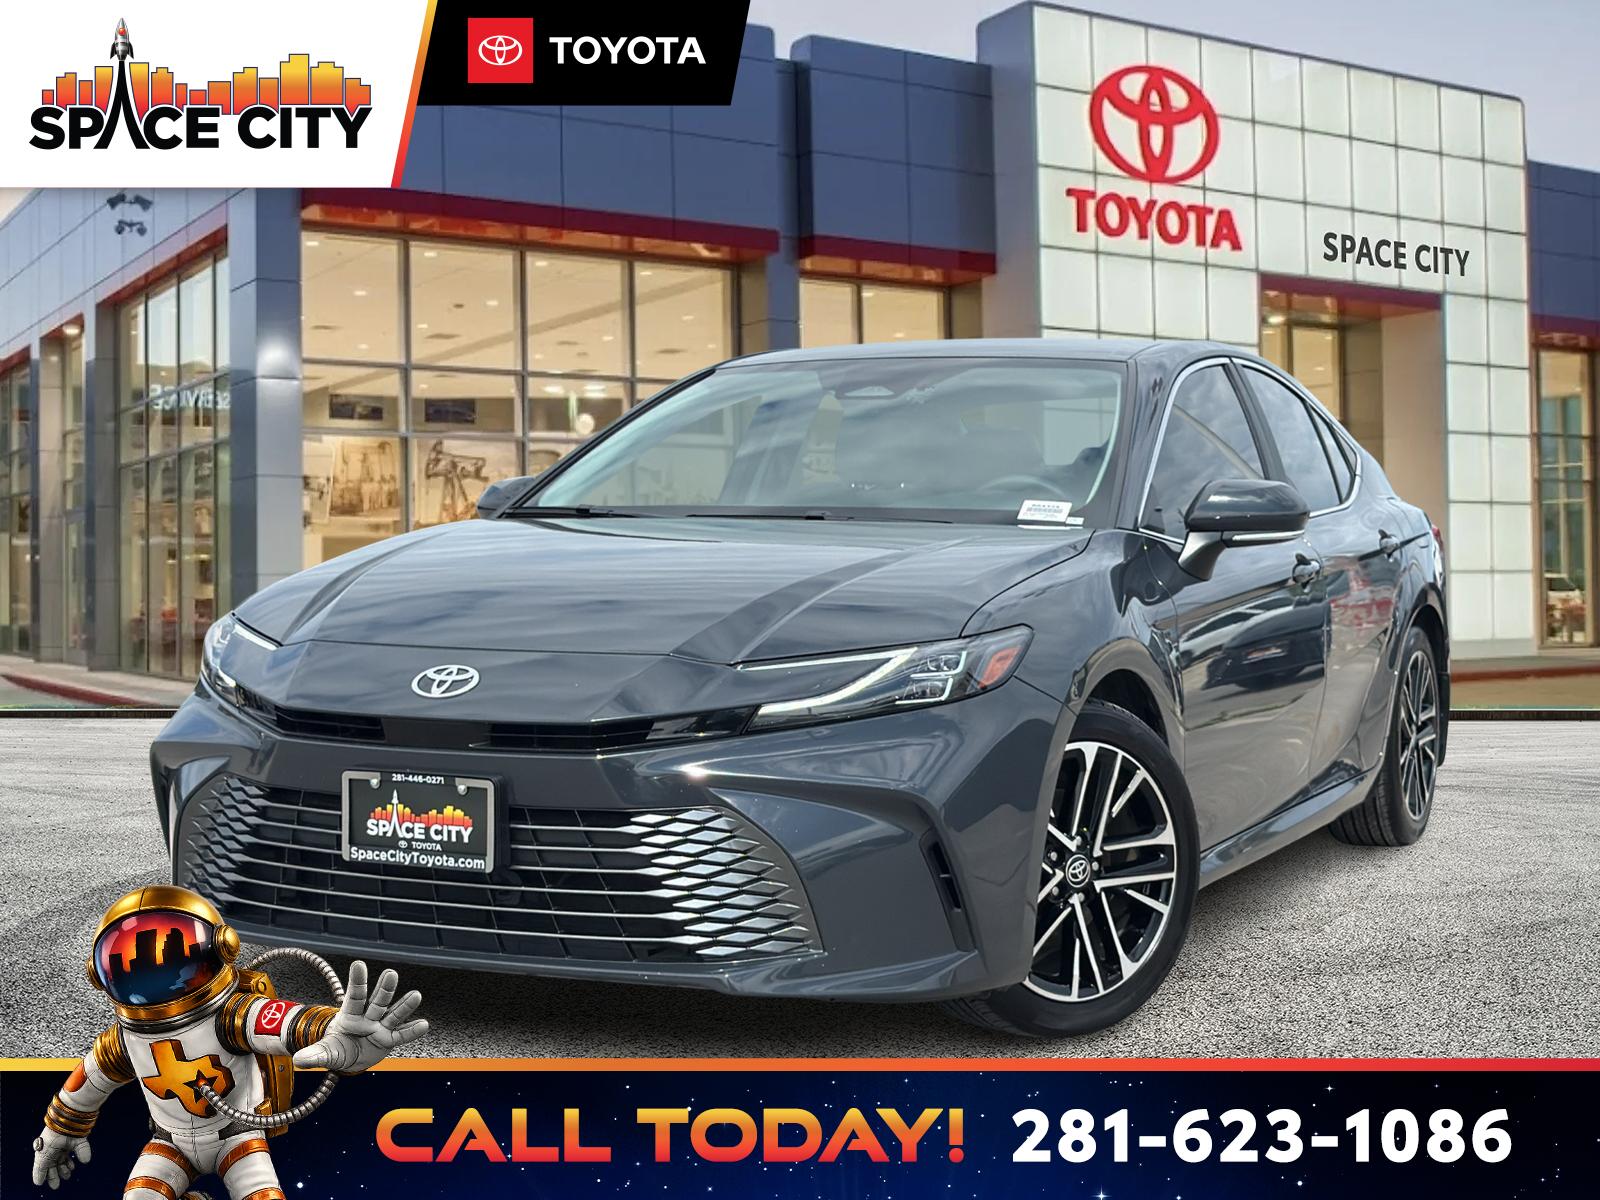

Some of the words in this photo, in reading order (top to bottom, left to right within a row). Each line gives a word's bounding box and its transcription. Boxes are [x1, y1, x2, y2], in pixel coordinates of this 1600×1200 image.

[1066, 187, 1243, 252] TOYOTA
[1323, 231, 1407, 270] SPACE
[1415, 243, 1470, 277] CITY
[391, 773, 445, 785] 281-446-0271
[366, 811, 425, 839] SPACE
[430, 824, 473, 843] CITY
[350, 846, 485, 870] SpaceCityToyota.com
[411, 841, 443, 851] TOYOTA
